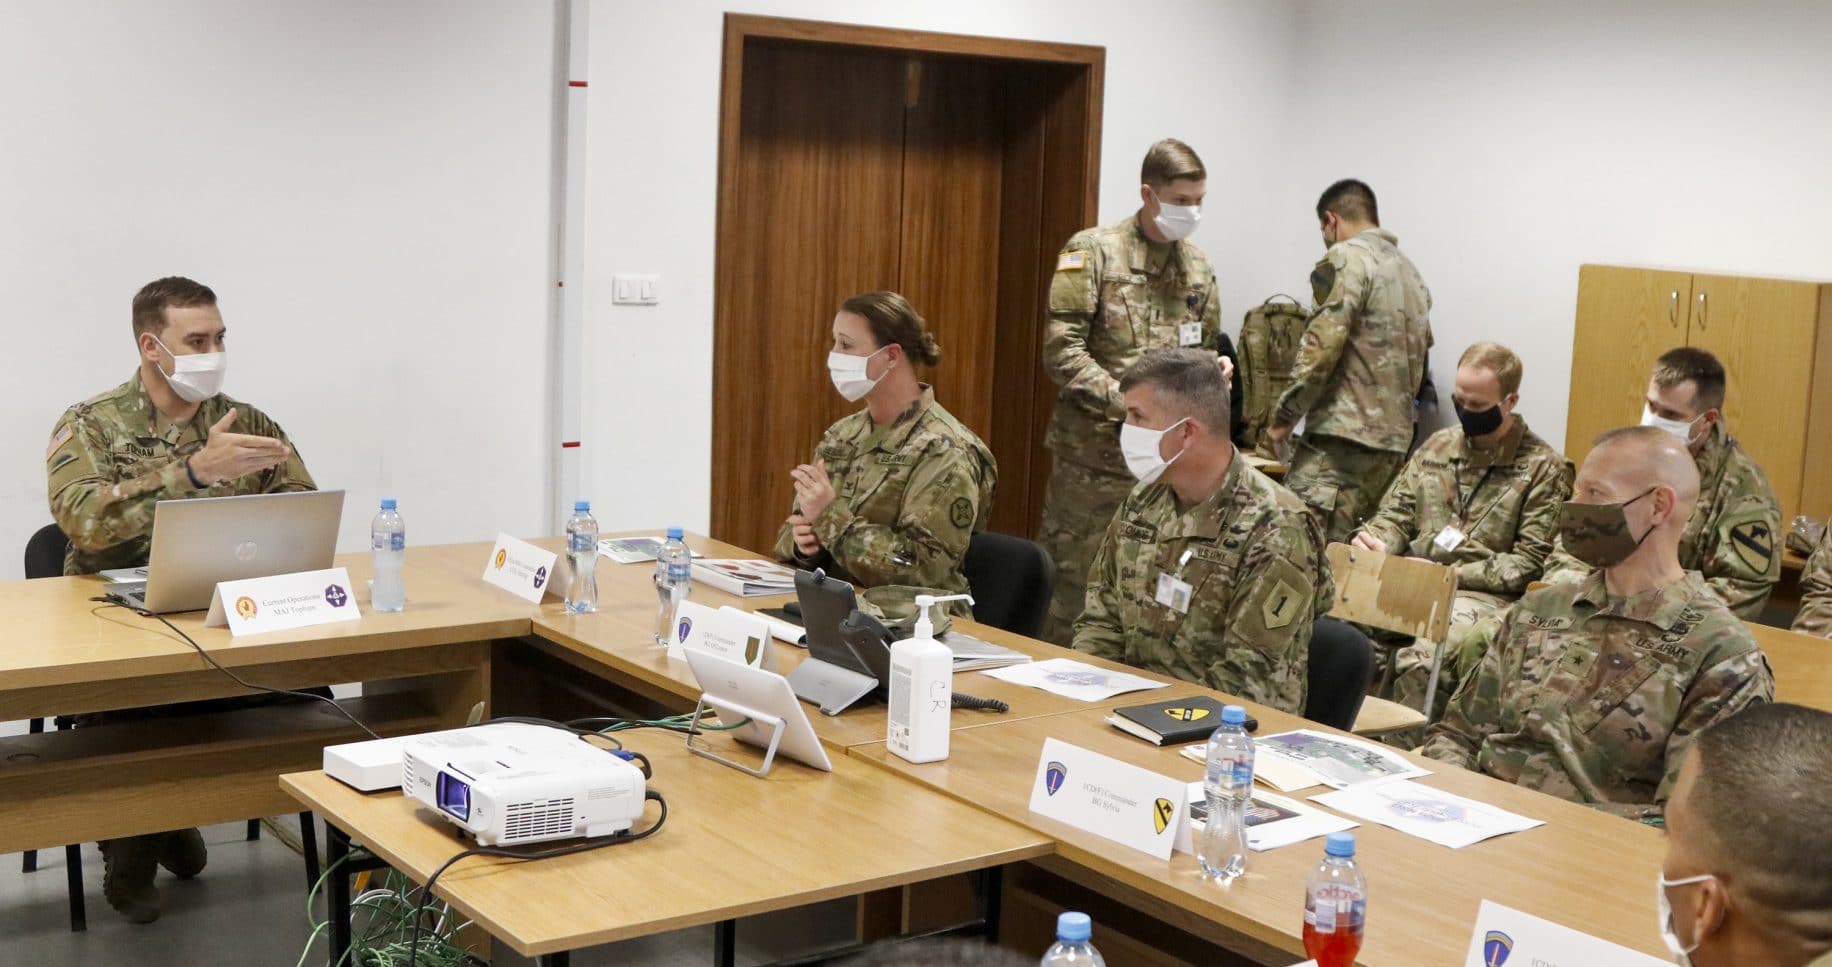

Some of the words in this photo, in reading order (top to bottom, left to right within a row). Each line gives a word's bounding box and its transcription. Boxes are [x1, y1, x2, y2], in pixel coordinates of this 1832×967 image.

[262, 597, 286, 607] Current
[1272, 596, 1287, 617] 1
[273, 607, 290, 616] MAJ
